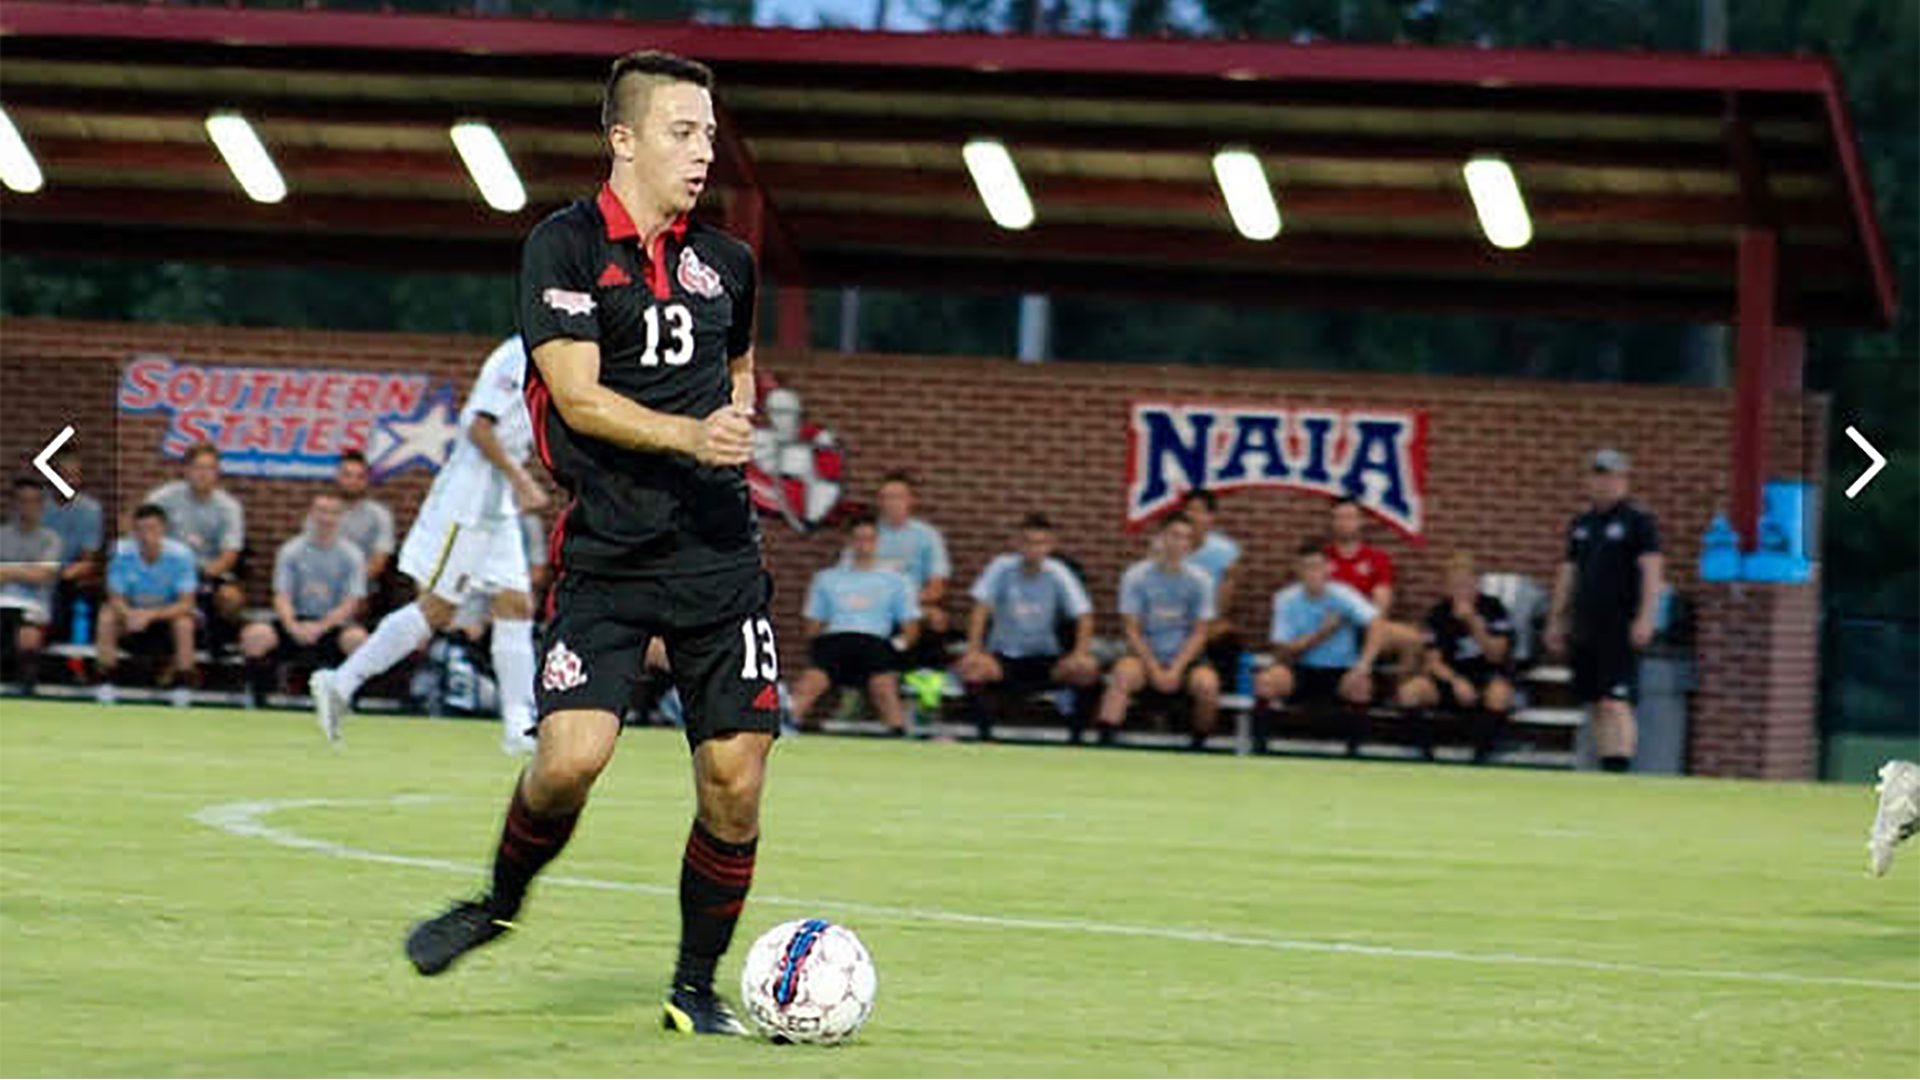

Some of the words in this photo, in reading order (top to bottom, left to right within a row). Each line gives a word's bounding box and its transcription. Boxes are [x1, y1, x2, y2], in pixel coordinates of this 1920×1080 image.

[640, 303, 695, 367] 13
[121, 357, 427, 413] SOUTHERN
[164, 408, 374, 456] STATES
[1138, 410, 1412, 518] NAIA
[740, 617, 778, 682] 13
